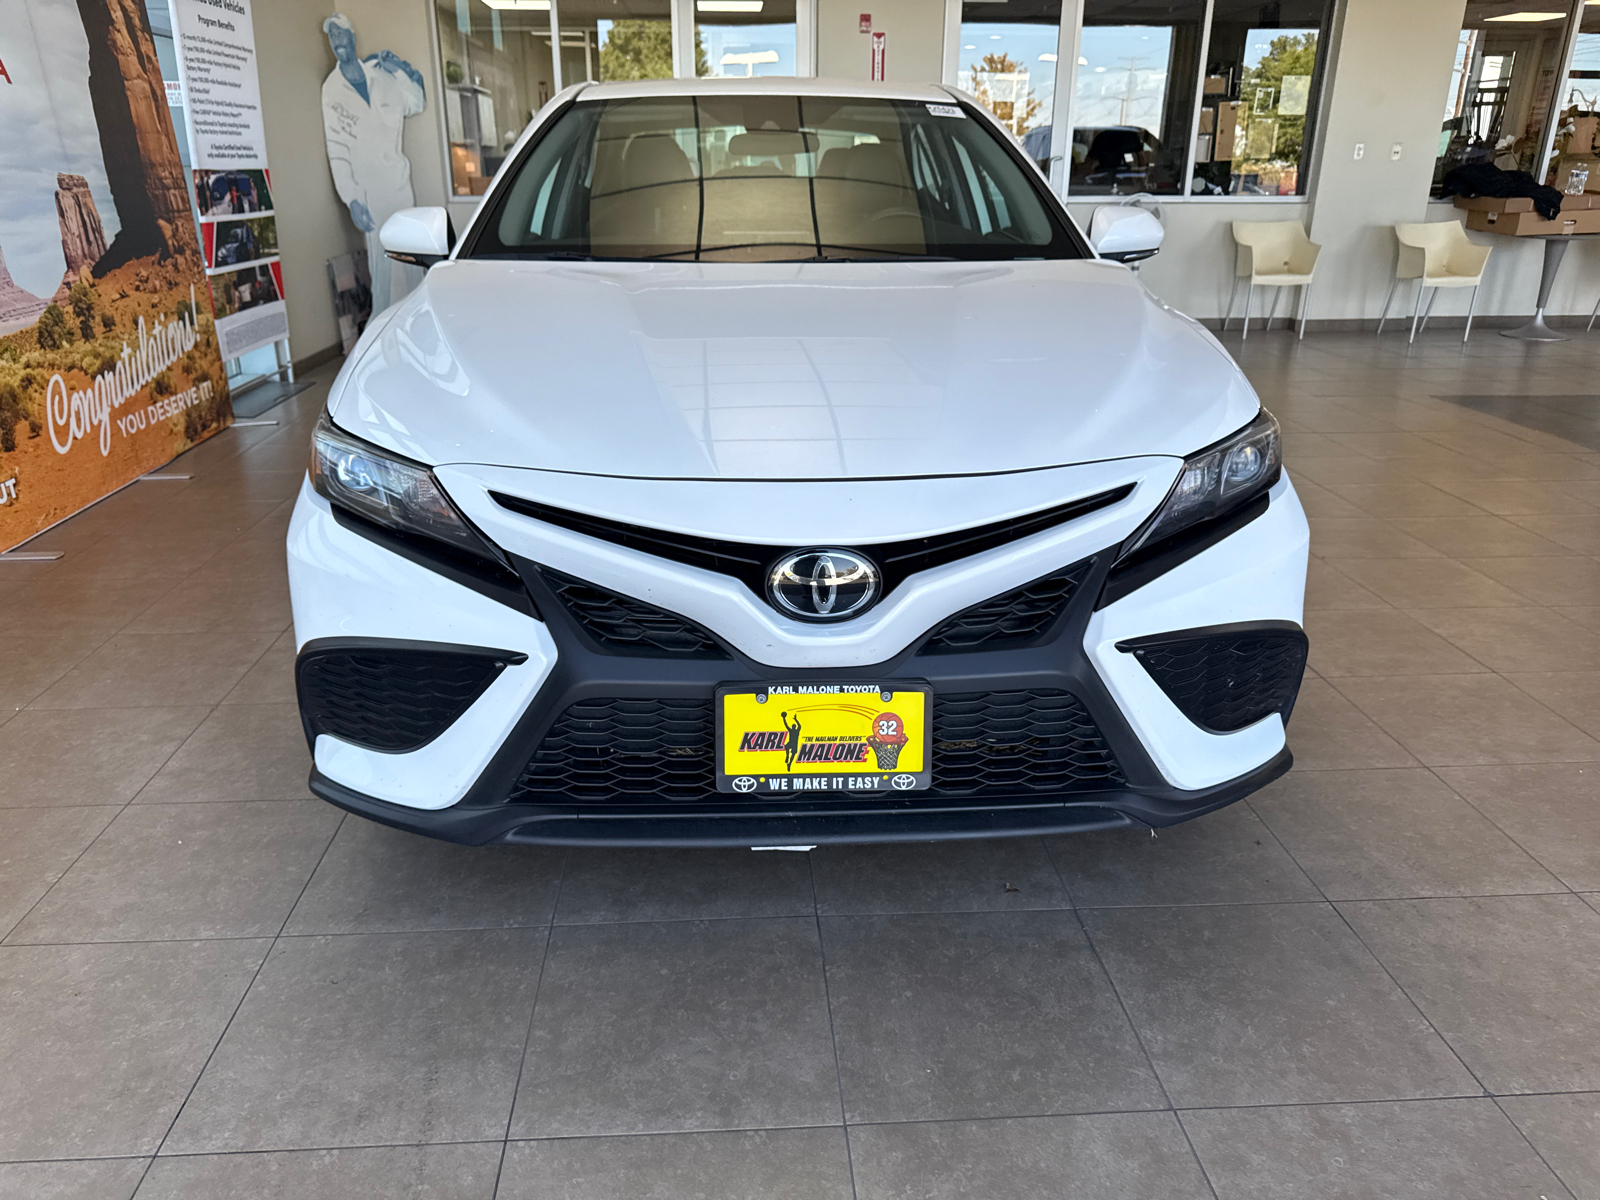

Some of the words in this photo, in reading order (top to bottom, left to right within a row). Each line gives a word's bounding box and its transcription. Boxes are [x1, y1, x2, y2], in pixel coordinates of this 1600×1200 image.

[197, 14, 217, 28] Program
[217, 19, 235, 32] Benefits
[46, 283, 201, 457] Congratulations!
[117, 412, 147, 437] YOU
[149, 389, 199, 425] DESERVE
[200, 380, 214, 404] IT!
[768, 686, 796, 695] KARL
[800, 685, 840, 695] MALONE
[843, 685, 881, 694] TOYOTA
[878, 720, 897, 736] 32
[738, 731, 790, 752] KARL
[795, 742, 872, 764] MALONE
[769, 778, 791, 790] WE
[793, 777, 828, 790] MAKE
[832, 777, 844, 789] IT
[846, 776, 880, 789] EASY
